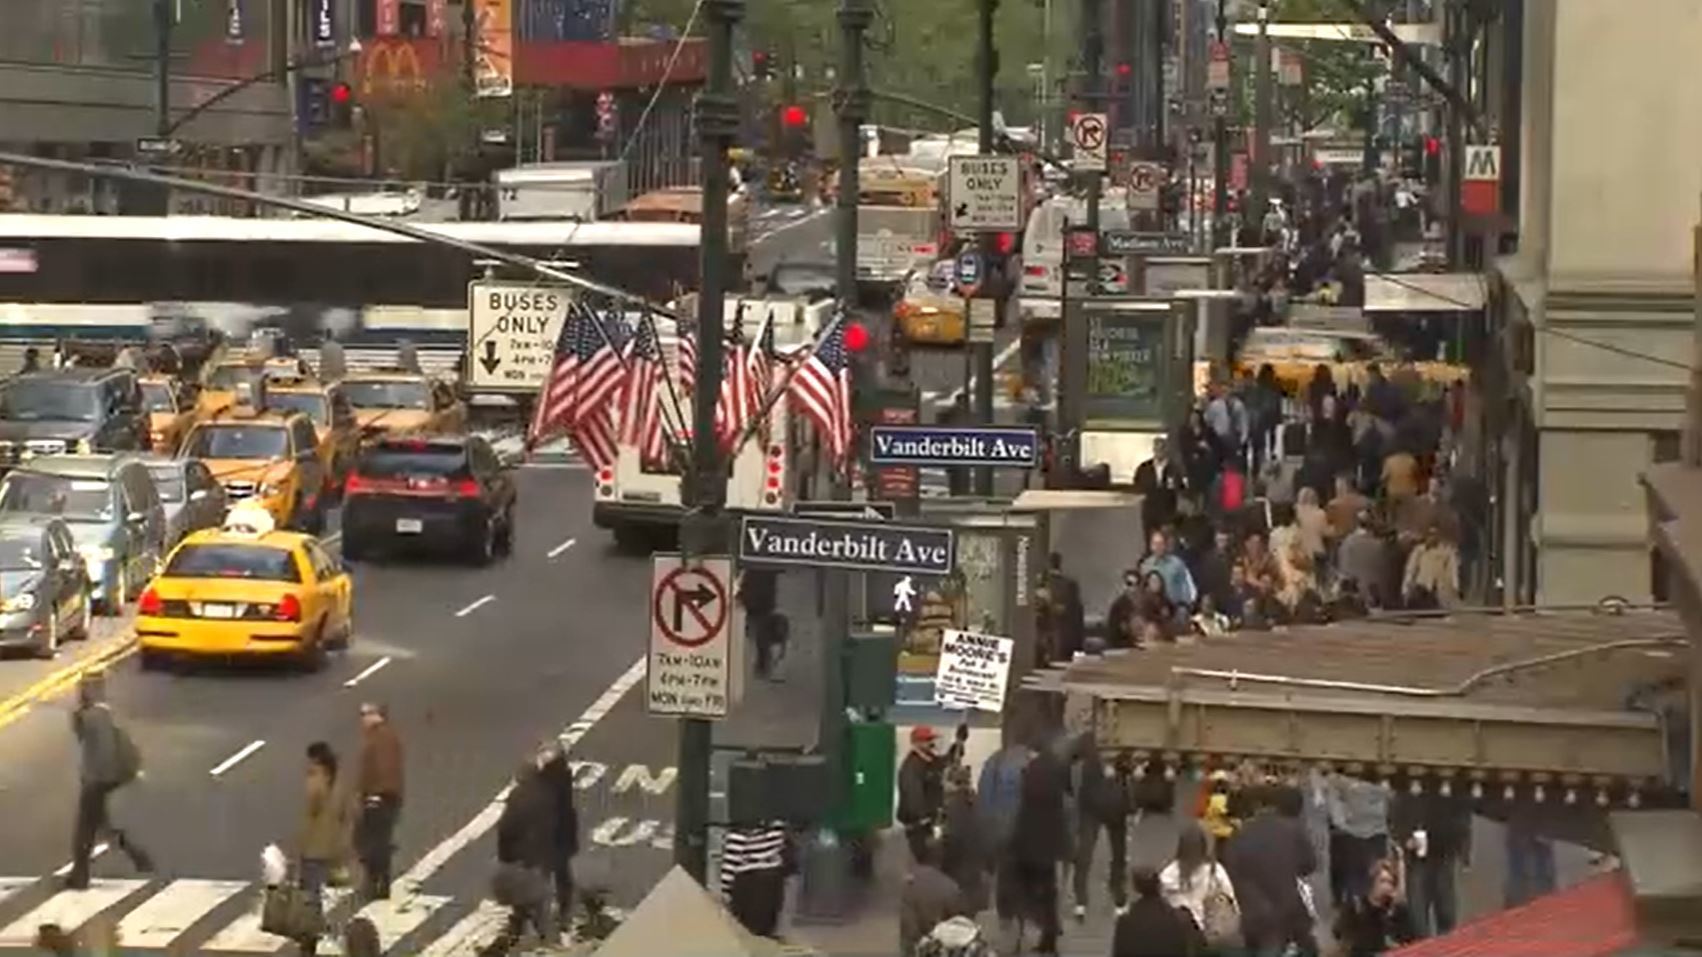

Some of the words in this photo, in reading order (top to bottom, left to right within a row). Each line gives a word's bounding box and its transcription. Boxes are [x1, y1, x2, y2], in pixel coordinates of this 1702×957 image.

[490, 293, 557, 311] BUSES
[498, 316, 548, 334] ONLY
[876, 435, 985, 457] Vanderbilt
[991, 439, 1031, 458] Ave
[748, 527, 887, 560] Vanderbilt
[895, 538, 946, 563] Ave
[956, 634, 999, 651] ANNIE
